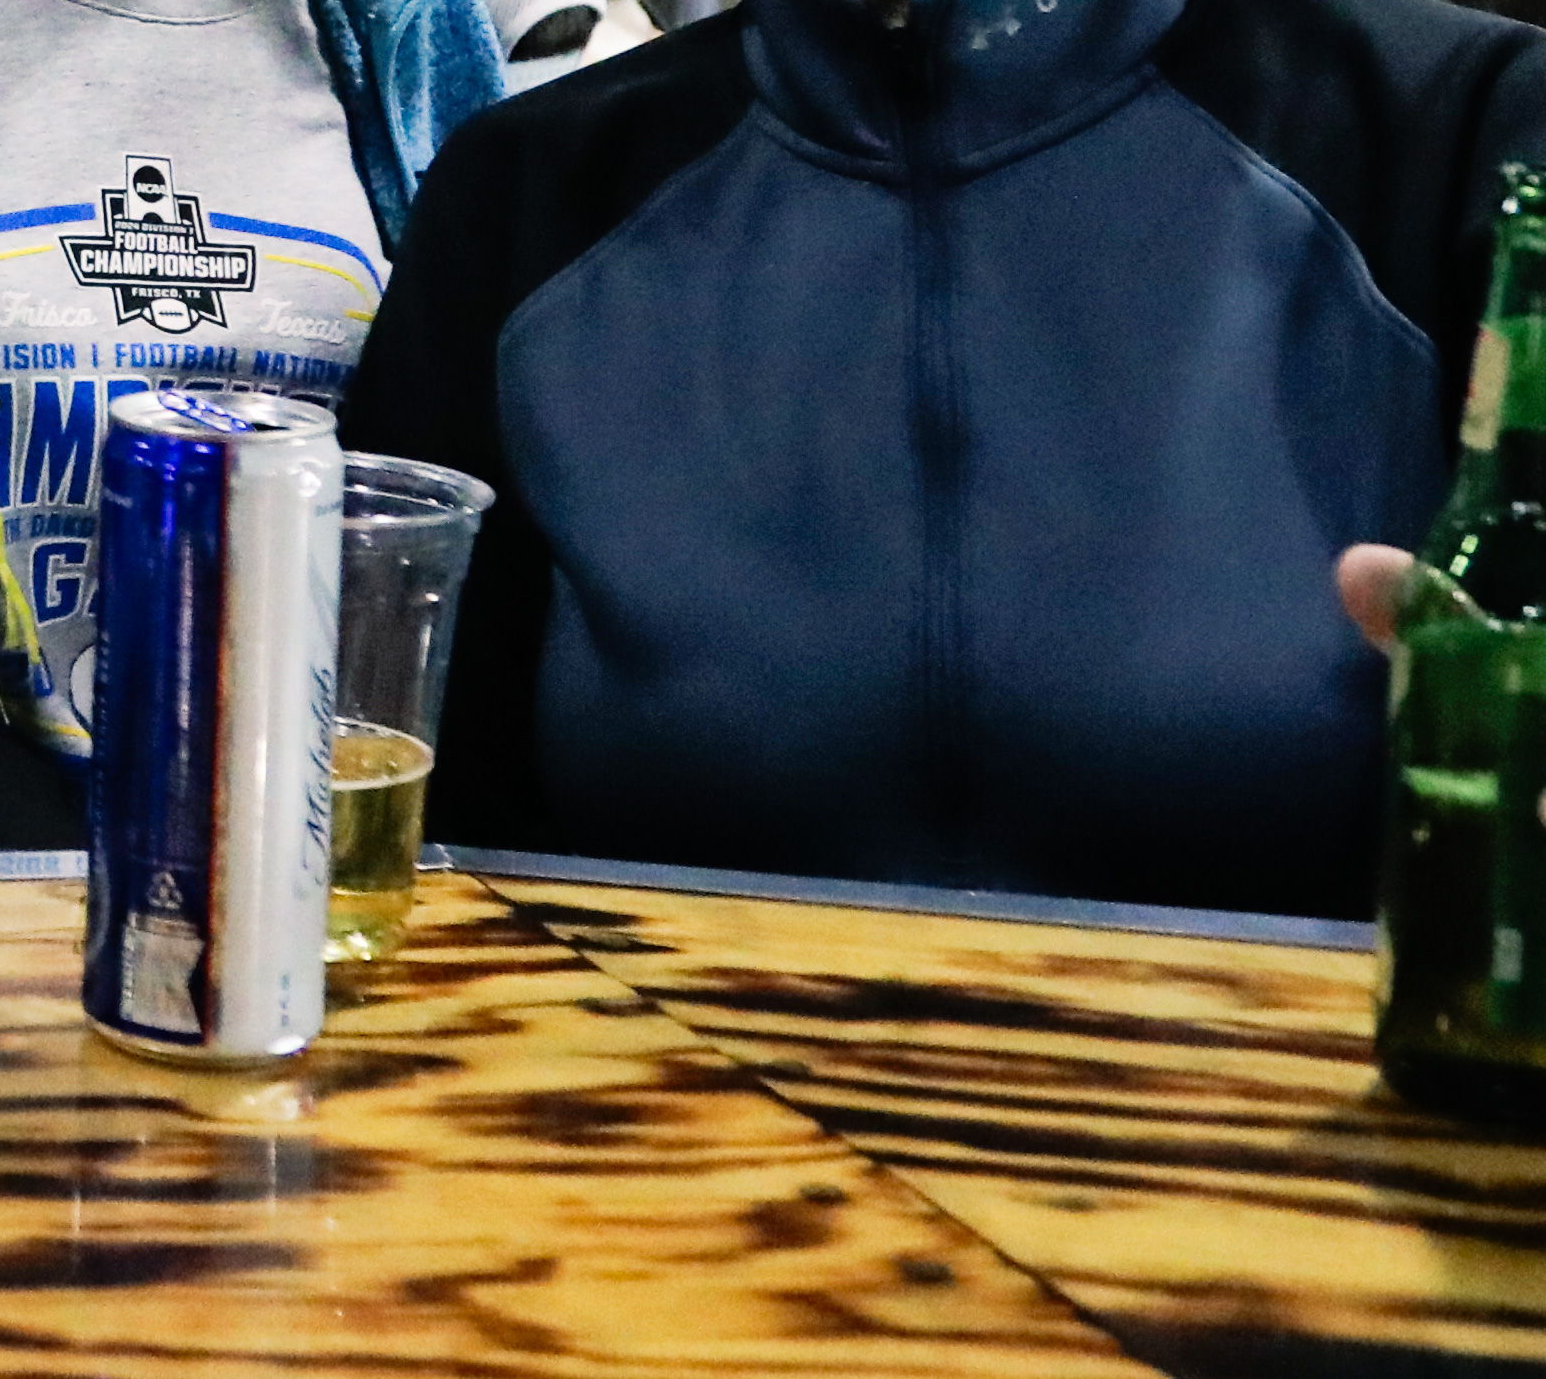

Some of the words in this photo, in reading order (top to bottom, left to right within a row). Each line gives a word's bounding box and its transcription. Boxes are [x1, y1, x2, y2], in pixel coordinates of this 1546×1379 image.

[114, 230, 198, 254] FOOTBALL
[79, 249, 247, 279] CHAMPIONSHIP
[131, 286, 183, 299] FRISCO,
[185, 289, 201, 299] TX
[0, 291, 98, 328] Frisco
[260, 298, 347, 345] Texas
[91, 341, 99, 369] I
[115, 342, 238, 373] FOOTBALL
